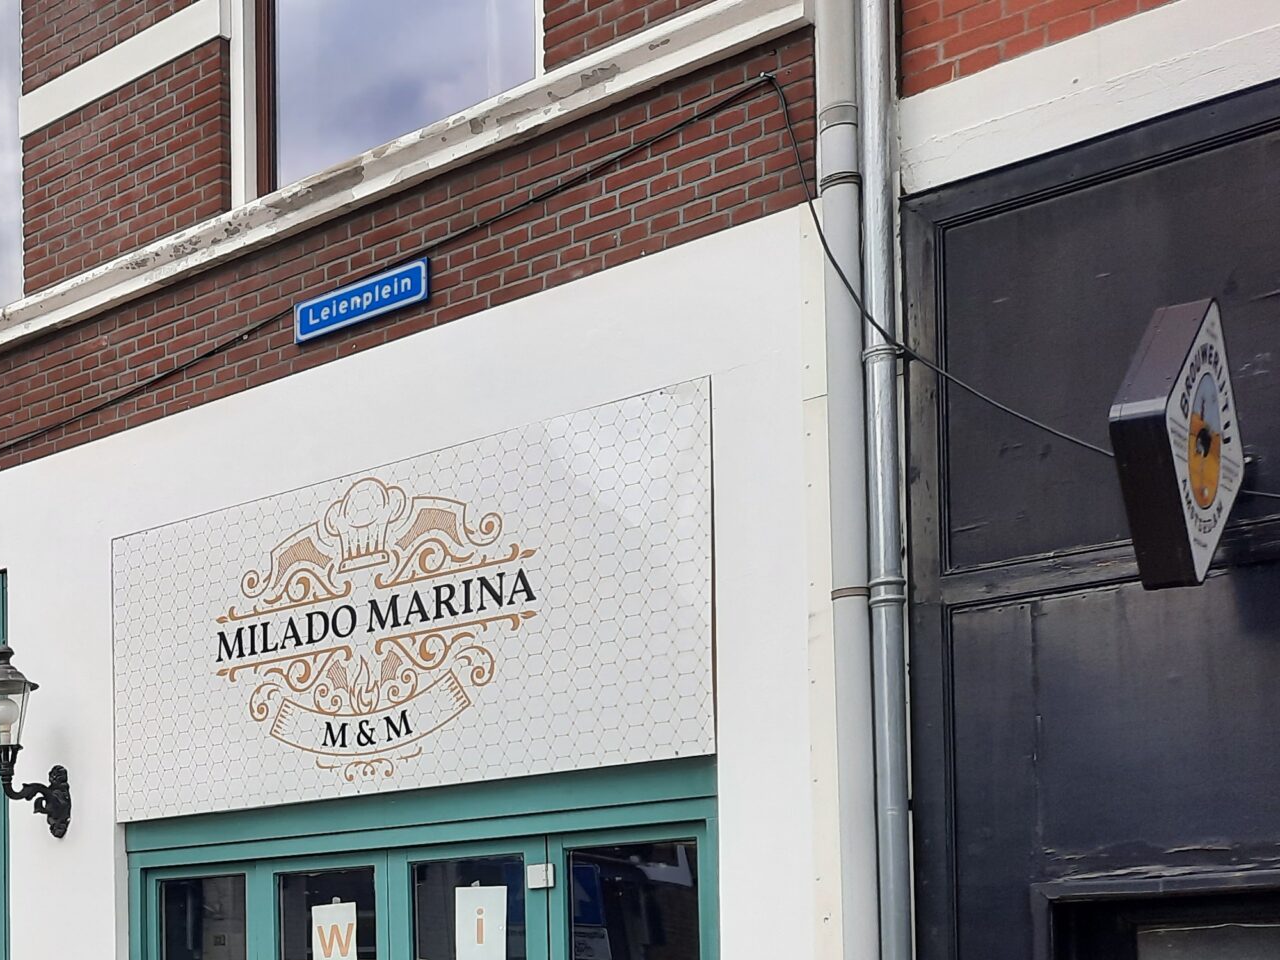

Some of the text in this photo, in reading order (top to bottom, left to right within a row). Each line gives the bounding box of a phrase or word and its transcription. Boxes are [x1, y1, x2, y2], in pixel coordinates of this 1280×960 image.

[308, 277, 412, 325] Leienplein
[215, 567, 537, 662] MILADO MARINA
[322, 709, 413, 748] M & M
